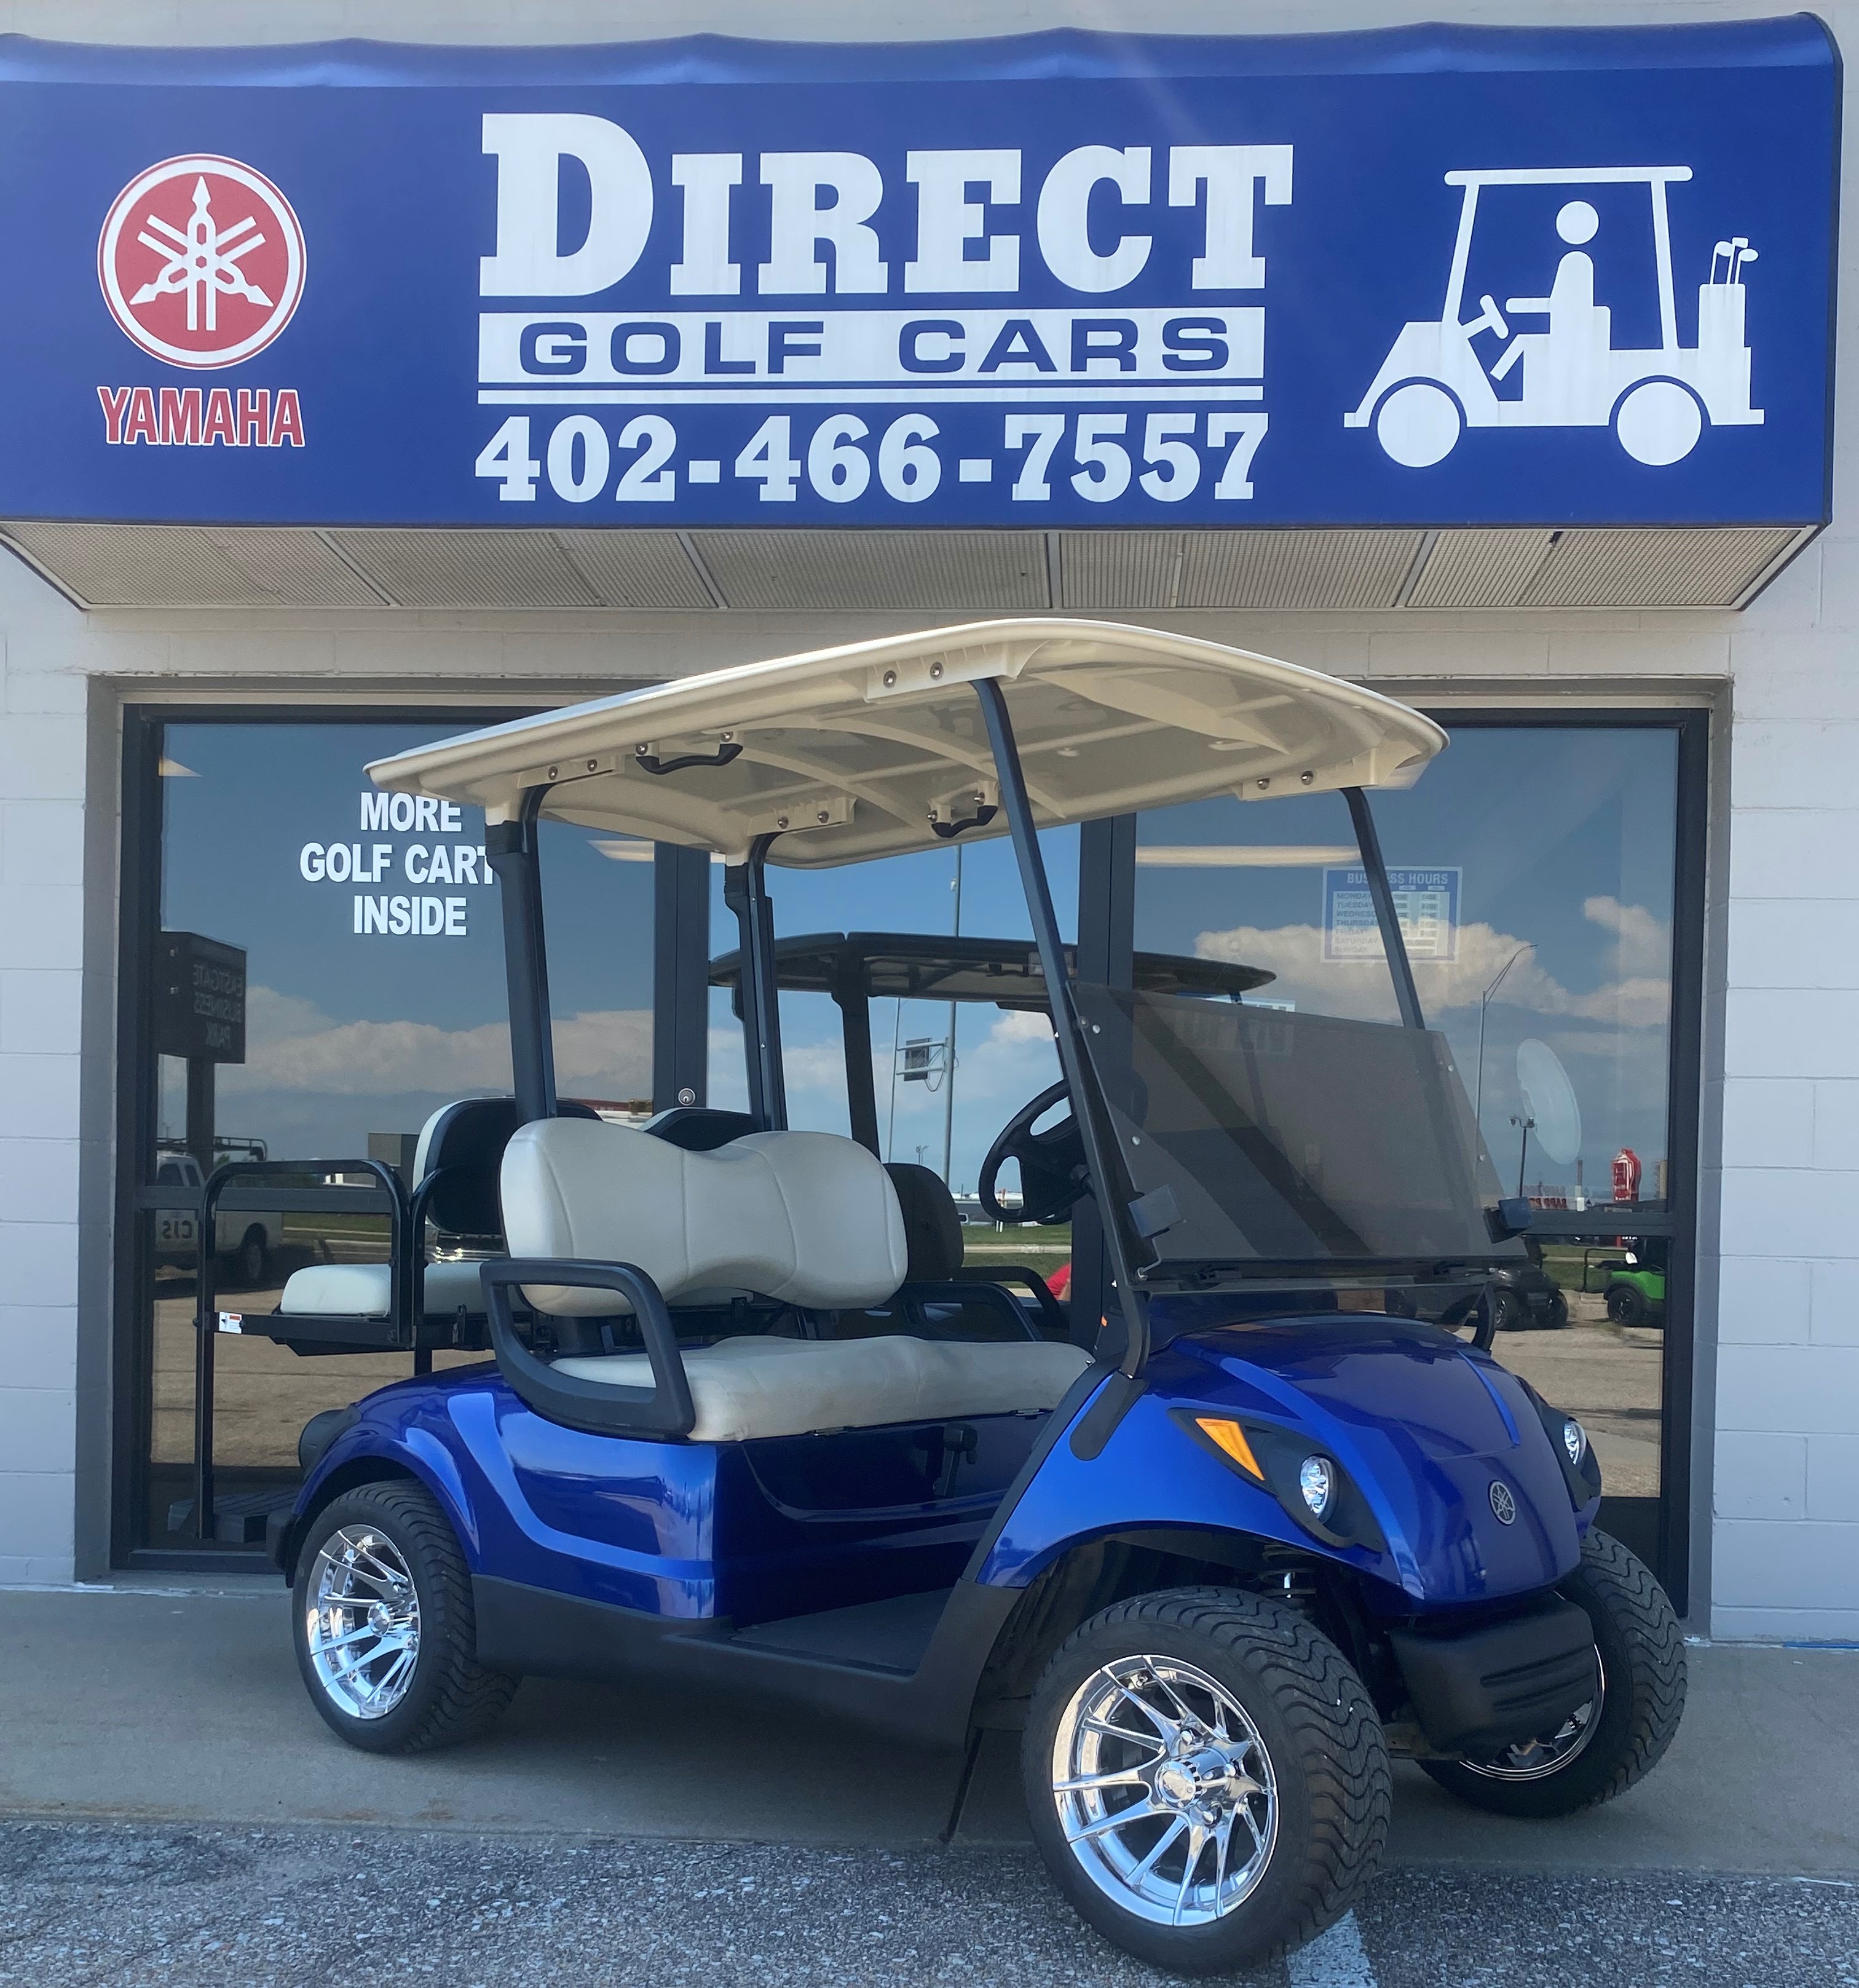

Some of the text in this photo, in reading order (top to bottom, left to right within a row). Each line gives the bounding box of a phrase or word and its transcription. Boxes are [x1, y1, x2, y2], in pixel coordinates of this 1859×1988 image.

[480, 113, 1293, 297] DIRECT
[519, 317, 1229, 376] GOLF CARS
[97, 386, 306, 447] YAMAHA
[475, 412, 1269, 503] 402-466-7557
[360, 792, 462, 832] MORE
[300, 842, 392, 882] GOLF
[1348, 873, 1448, 884] BUSESS HOURS
[353, 895, 467, 935] INSIDE
